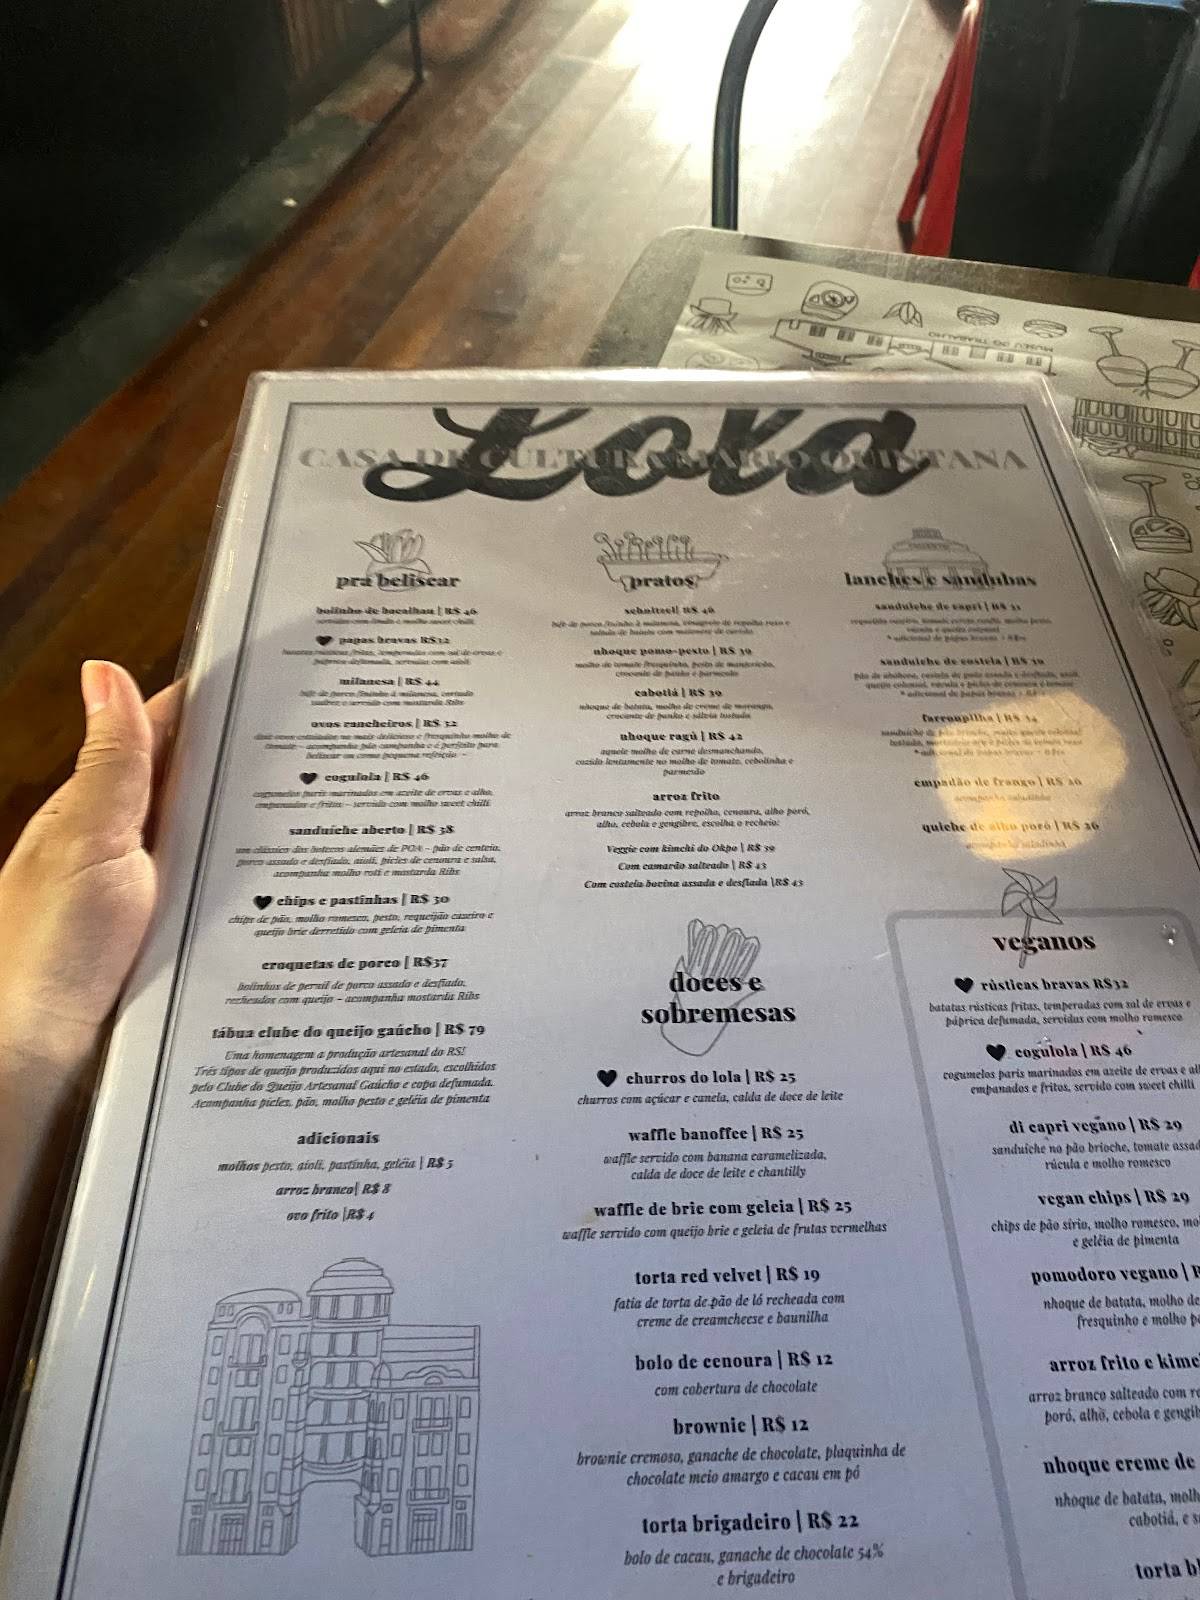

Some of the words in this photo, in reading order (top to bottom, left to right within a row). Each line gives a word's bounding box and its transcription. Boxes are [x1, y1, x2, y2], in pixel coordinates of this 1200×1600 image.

[298, 447, 404, 468] CASA
[363, 408, 931, 502] Lola
[335, 575, 373, 589] pra
[376, 573, 459, 587] beliscar
[629, 575, 698, 589] pratos
[652, 793, 687, 801] arroz
[690, 791, 720, 800] frito
[276, 895, 315, 907] chips
[329, 894, 398, 907] pastinhas
[409, 893, 429, 904] R$
[433, 895, 449, 905] 30
[993, 935, 1095, 954] veganos
[261, 957, 334, 971] croquetas
[337, 957, 355, 968] de
[358, 959, 401, 970] porco
[413, 955, 448, 969] R$37
[669, 971, 744, 992] doces
[748, 976, 763, 994] e
[1042, 978, 1089, 990] bravas
[641, 1001, 795, 1023] sobremesas
[257, 1025, 299, 1038] clube
[303, 1025, 323, 1037] do
[325, 1024, 374, 1039] queijo
[444, 1023, 465, 1034] R$
[468, 1025, 485, 1037] 79
[1015, 1041, 1078, 1059] cogulola
[1115, 1043, 1132, 1057] 46
[625, 1070, 686, 1084] churros
[689, 1070, 709, 1083] do
[712, 1070, 741, 1082] lola
[754, 1069, 775, 1083] R$
[780, 1072, 796, 1084] 25
[629, 1127, 676, 1141] waffle
[680, 1126, 747, 1140] banoffee
[761, 1125, 782, 1139] R$
[787, 1129, 803, 1142] 25
[1009, 1120, 1024, 1133] di
[1028, 1119, 1068, 1135] capri
[1072, 1121, 1126, 1134] vegano
[1139, 1117, 1160, 1130] R$
[1165, 1120, 1182, 1132] 29
[297, 1130, 380, 1145] adicionais
[217, 1159, 261, 1171] molhos
[260, 1160, 294, 1173] pesto,
[296, 1159, 325, 1171] aioli,
[327, 1158, 380, 1172] pastinha,
[445, 1159, 454, 1170] 5
[1082, 1160, 1089, 1169] e
[1090, 1156, 1126, 1168] molho
[1126, 1159, 1171, 1168] romesco
[275, 1186, 310, 1195] arroz
[381, 1183, 391, 1194] 8
[1038, 1194, 1084, 1208] vegan
[1088, 1189, 1131, 1206] chips
[1145, 1188, 1167, 1203] R$
[1171, 1192, 1189, 1204] 29
[594, 1202, 644, 1216] waffle
[648, 1201, 666, 1215] de
[671, 1200, 704, 1215] brie
[708, 1203, 742, 1214] com
[746, 1199, 794, 1216] geleia
[808, 1197, 829, 1213] R$
[834, 1201, 851, 1215] 25
[1071, 1237, 1079, 1247] e
[1115, 1233, 1130, 1246] de
[1131, 1233, 1180, 1248] pimenta
[635, 1267, 676, 1284] torta
[680, 1267, 708, 1283] red
[713, 1266, 761, 1282] velvet
[776, 1265, 798, 1281] R$
[804, 1269, 820, 1283] 19
[1031, 1266, 1116, 1285] pomodoro
[1120, 1268, 1178, 1282] vegano
[636, 1317, 672, 1327] creme
[674, 1313, 689, 1326] de
[690, 1312, 764, 1326] creamcheese
[766, 1314, 773, 1324] e
[775, 1309, 829, 1323] baunilha
[635, 1354, 672, 1370] bolo
[678, 1353, 697, 1369] de
[702, 1355, 772, 1368] cenoura
[788, 1350, 810, 1366] R$
[816, 1354, 832, 1365] 12
[1049, 1359, 1096, 1371] arroz
[1100, 1354, 1139, 1370] frito
[1144, 1358, 1153, 1369] e
[653, 1386, 680, 1396] com
[681, 1381, 742, 1395] cobertura
[743, 1380, 759, 1393] de
[761, 1378, 818, 1393] chocolate
[673, 1416, 746, 1434] brownie
[762, 1415, 785, 1433] R$
[791, 1419, 808, 1431] 12
[1043, 1454, 1110, 1477] nhoque
[1115, 1457, 1169, 1471] creme
[1174, 1451, 1195, 1470] de
[626, 1469, 686, 1486] chocolate
[688, 1469, 720, 1484] meio
[720, 1470, 770, 1485] amargo
[772, 1471, 780, 1481] e
[782, 1469, 820, 1481] cacau
[821, 1469, 842, 1480] em
[843, 1464, 861, 1482] pó
[642, 1514, 686, 1533] torta
[692, 1512, 790, 1535] brigadeiro
[807, 1510, 832, 1530] R$
[838, 1514, 858, 1528] 22
[716, 1574, 724, 1586] e
[726, 1567, 796, 1588] brigadeiro
